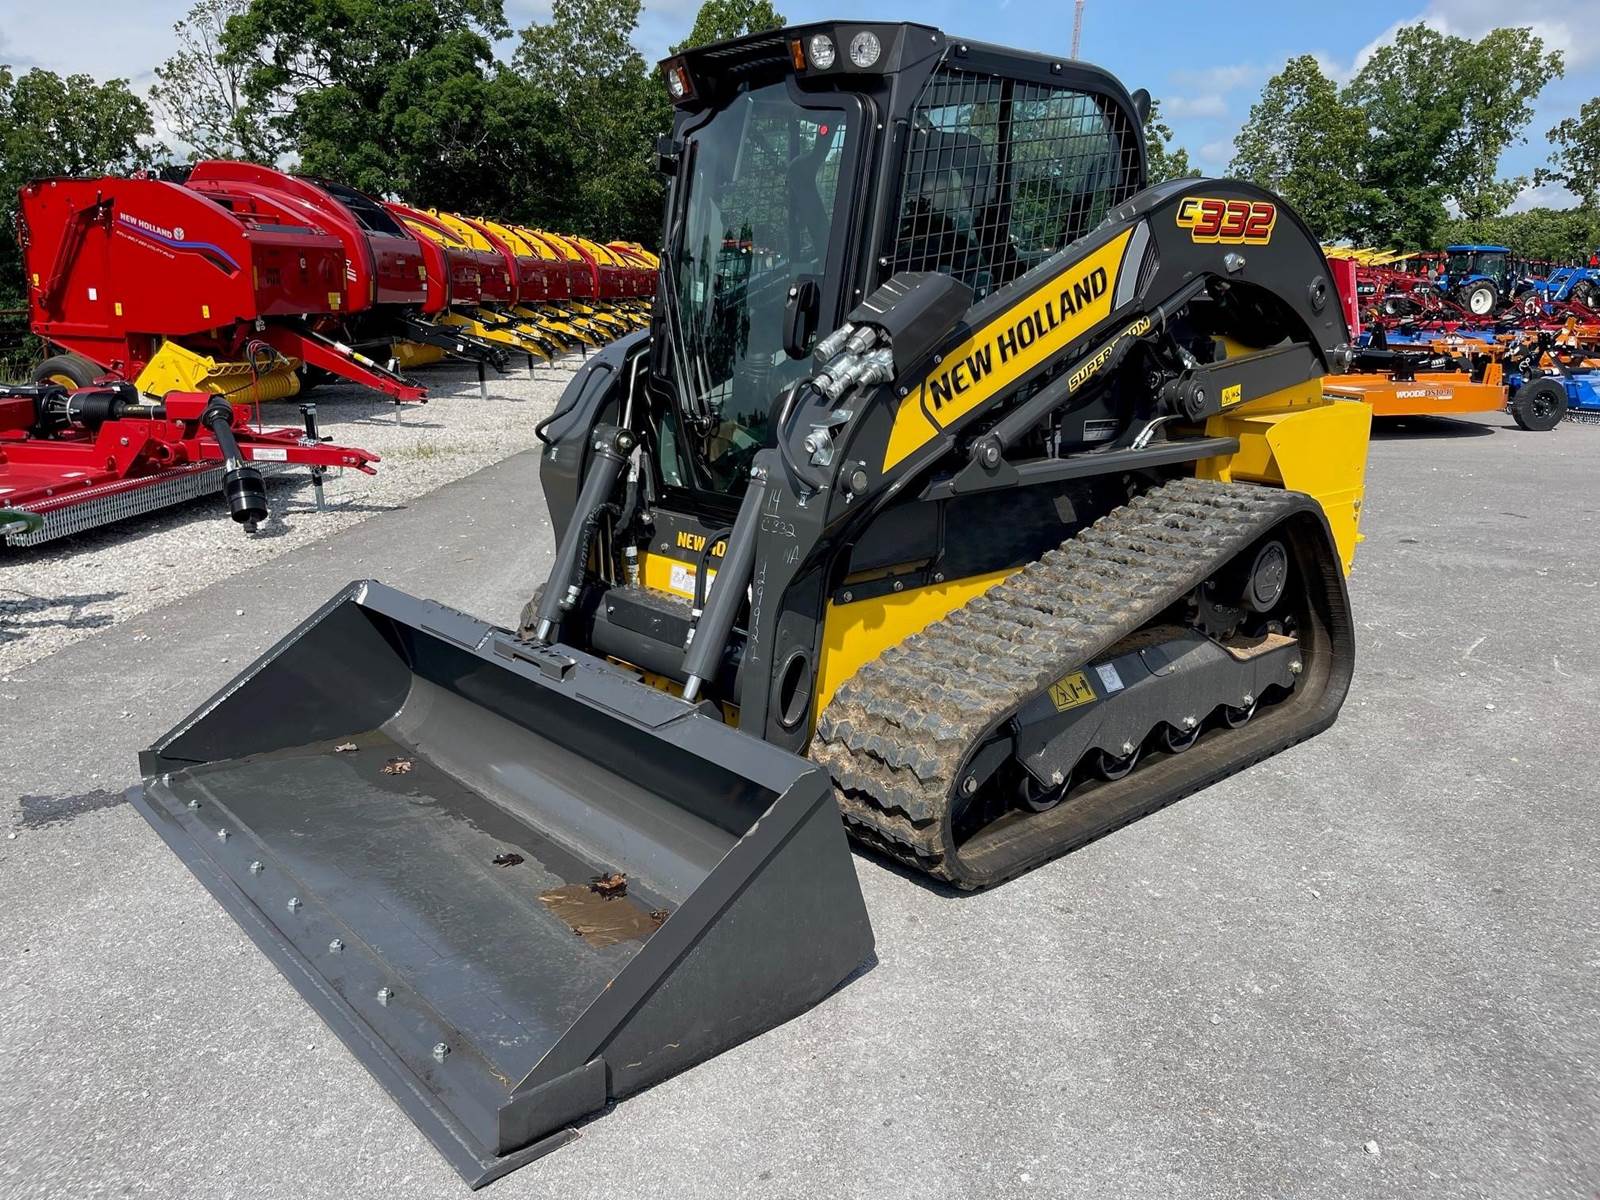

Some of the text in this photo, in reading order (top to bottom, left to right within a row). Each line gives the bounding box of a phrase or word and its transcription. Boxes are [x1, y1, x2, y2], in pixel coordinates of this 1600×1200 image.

[120, 212, 173, 240] NEW HOLLAND
[1176, 197, 1276, 245] C332
[928, 266, 1107, 411] NEW HOLLAND
[1068, 346, 1113, 393] SUPER
[1396, 389, 1425, 399] WOODS
[677, 531, 706, 552] NEW
